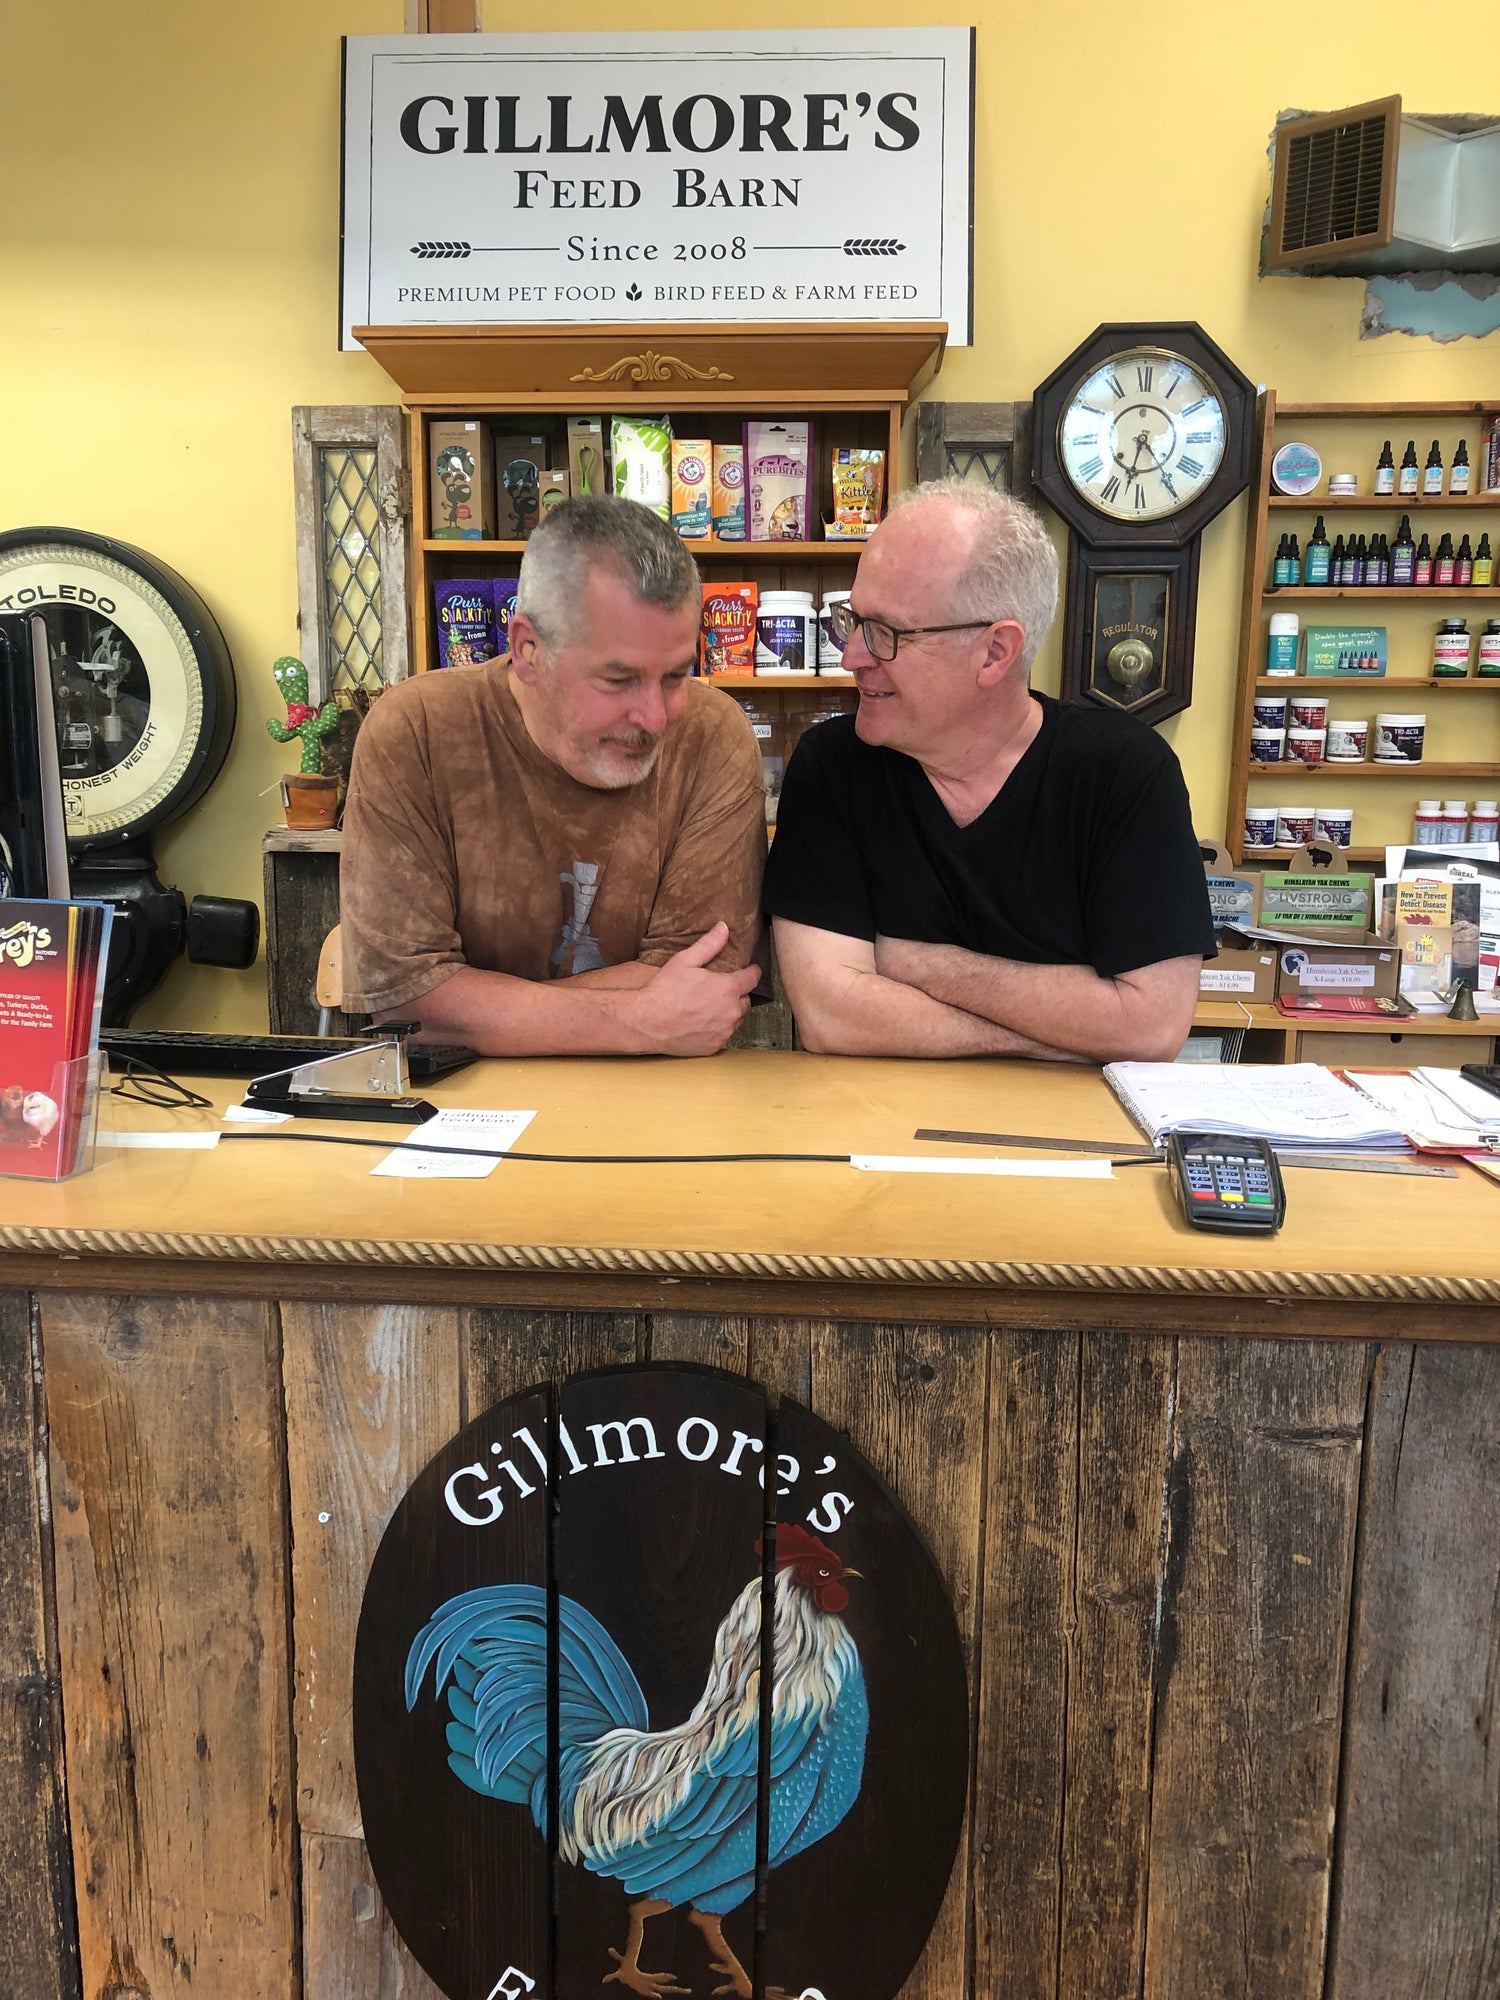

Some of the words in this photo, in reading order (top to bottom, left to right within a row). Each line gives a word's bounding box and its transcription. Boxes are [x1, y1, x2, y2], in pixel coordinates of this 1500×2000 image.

[399, 91, 921, 154] GILLMORE'S
[567, 235, 658, 263] Since
[673, 235, 748, 262] 2008
[398, 287, 501, 302] PREMIUM
[508, 287, 547, 302] PET
[554, 286, 616, 302] FOOD
[654, 286, 705, 301] BIRD
[712, 286, 765, 301] FEED
[771, 286, 788, 301] &
[795, 285, 857, 301] FARM
[863, 285, 918, 301] FEED
[0, 584, 117, 615] TOLEDO
[448, 594, 485, 610] Purr
[709, 598, 734, 612] Purr
[761, 619, 797, 629] TRI-ACTA
[467, 631, 487, 640] fromm
[1102, 622, 1158, 640] REGULATOR
[724, 634, 746, 644] fromm
[62, 769, 118, 790] HONEST
[122, 721, 157, 771] WEIGHT
[1328, 879, 1350, 887] CHEWS
[1400, 890, 1415, 898] How
[1415, 891, 1422, 899] to
[1423, 891, 1448, 900] Prevent
[1400, 898, 1421, 908] Detect
[1422, 899, 1447, 909] Disease
[1405, 940, 1441, 952] Chick
[1405, 951, 1441, 963] Guide
[1306, 967, 1337, 975] Himalayan
[1350, 967, 1370, 975] Chews
[1231, 974, 1251, 982] Chews
[7, 1001, 29, 1010] Turkeys,
[31, 1003, 49, 1011] Ducks,
[444, 1413, 855, 1534] Gillmore's
